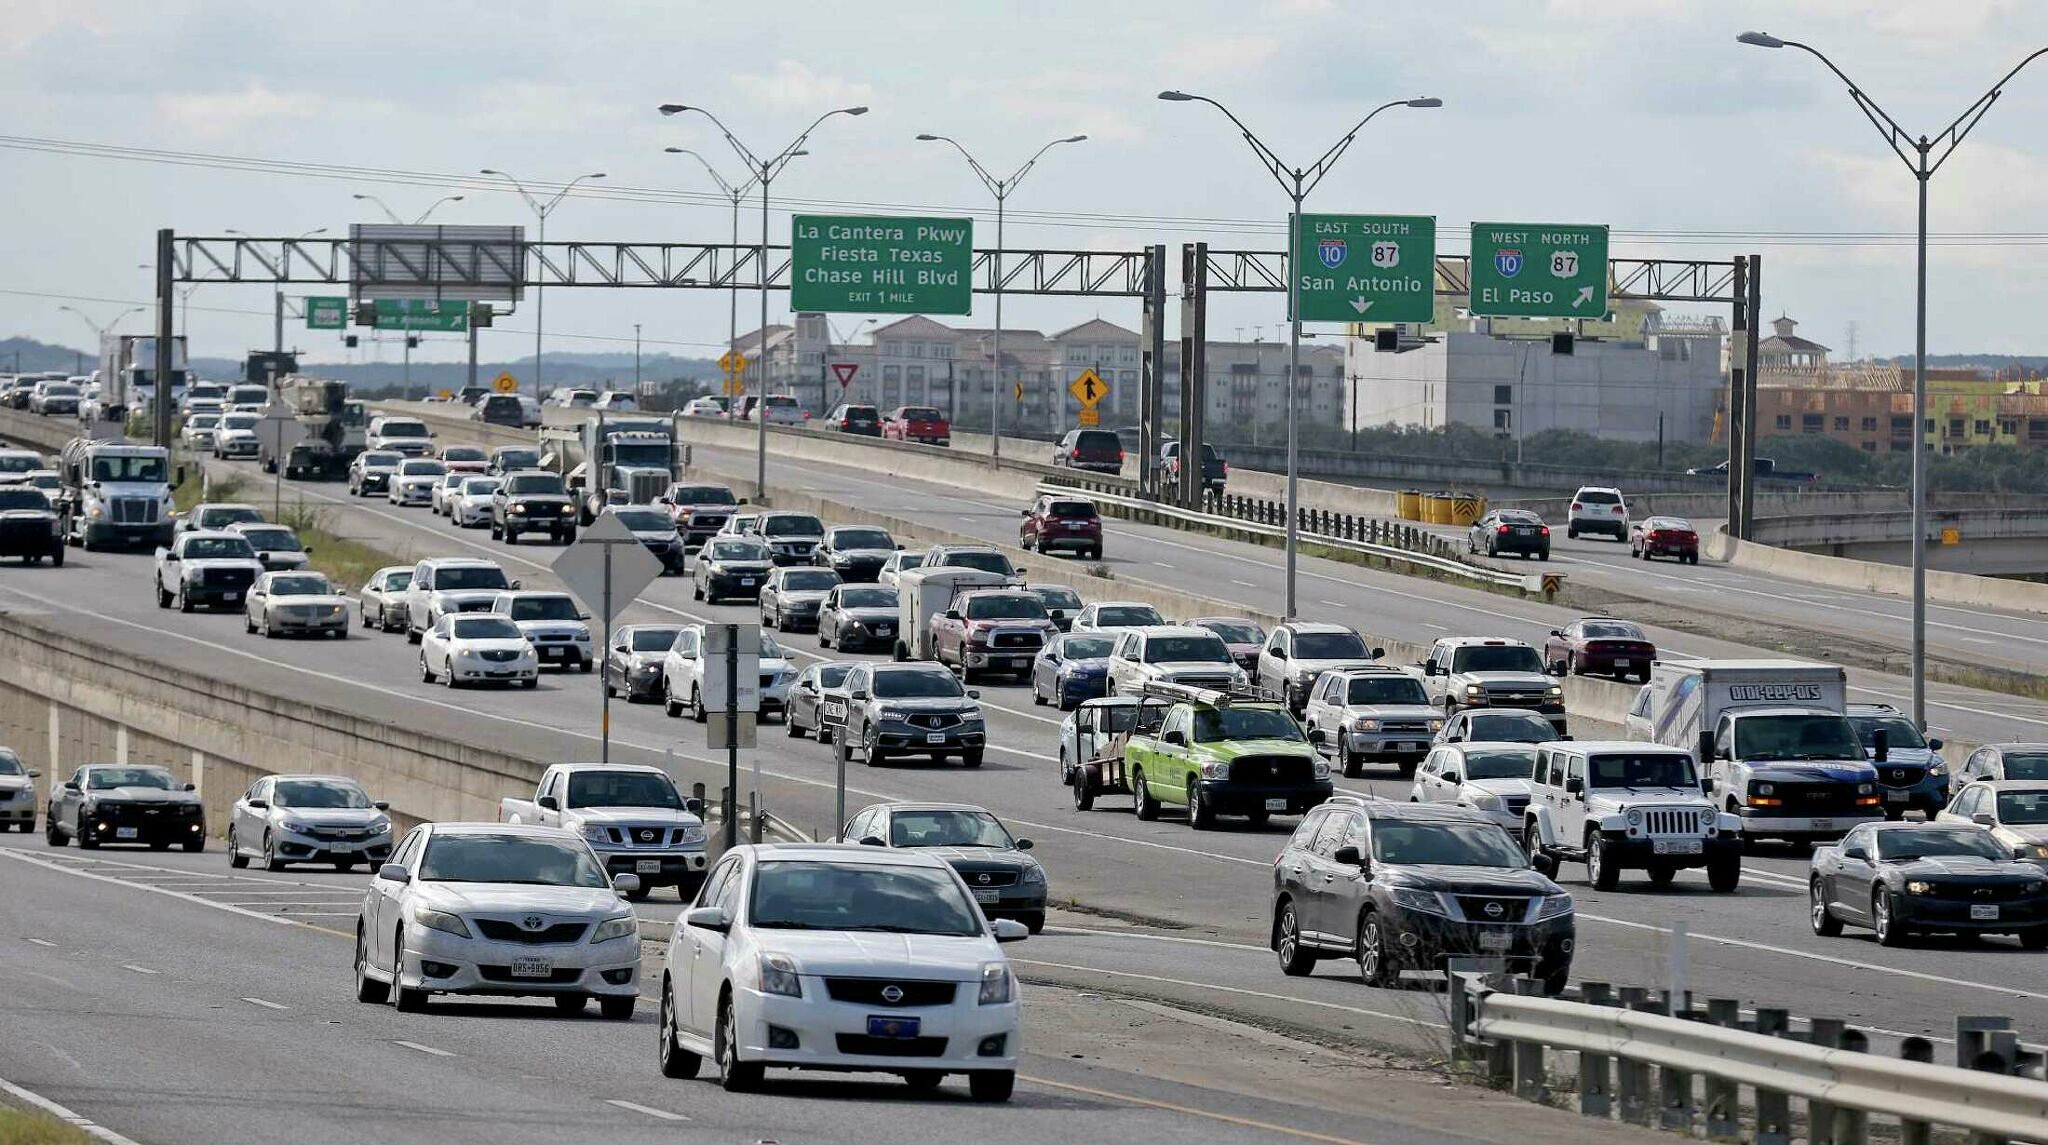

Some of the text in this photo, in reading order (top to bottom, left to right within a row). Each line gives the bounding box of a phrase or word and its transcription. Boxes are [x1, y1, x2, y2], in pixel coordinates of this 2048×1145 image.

[798, 224, 966, 245] La Cantera Pkwy
[1315, 222, 1410, 235] EAST SOUTH
[1491, 232, 1590, 245] WEST NORTH
[821, 246, 943, 263] Fiesta Texas
[1324, 246, 1397, 262] 10 87
[1500, 256, 1576, 272] 10 87
[805, 268, 958, 285] Chase Hill Blvd
[1301, 275, 1422, 293] San Antonio
[848, 291, 914, 304] EXIT 1 MILE
[1482, 287, 1554, 304] El Paso
